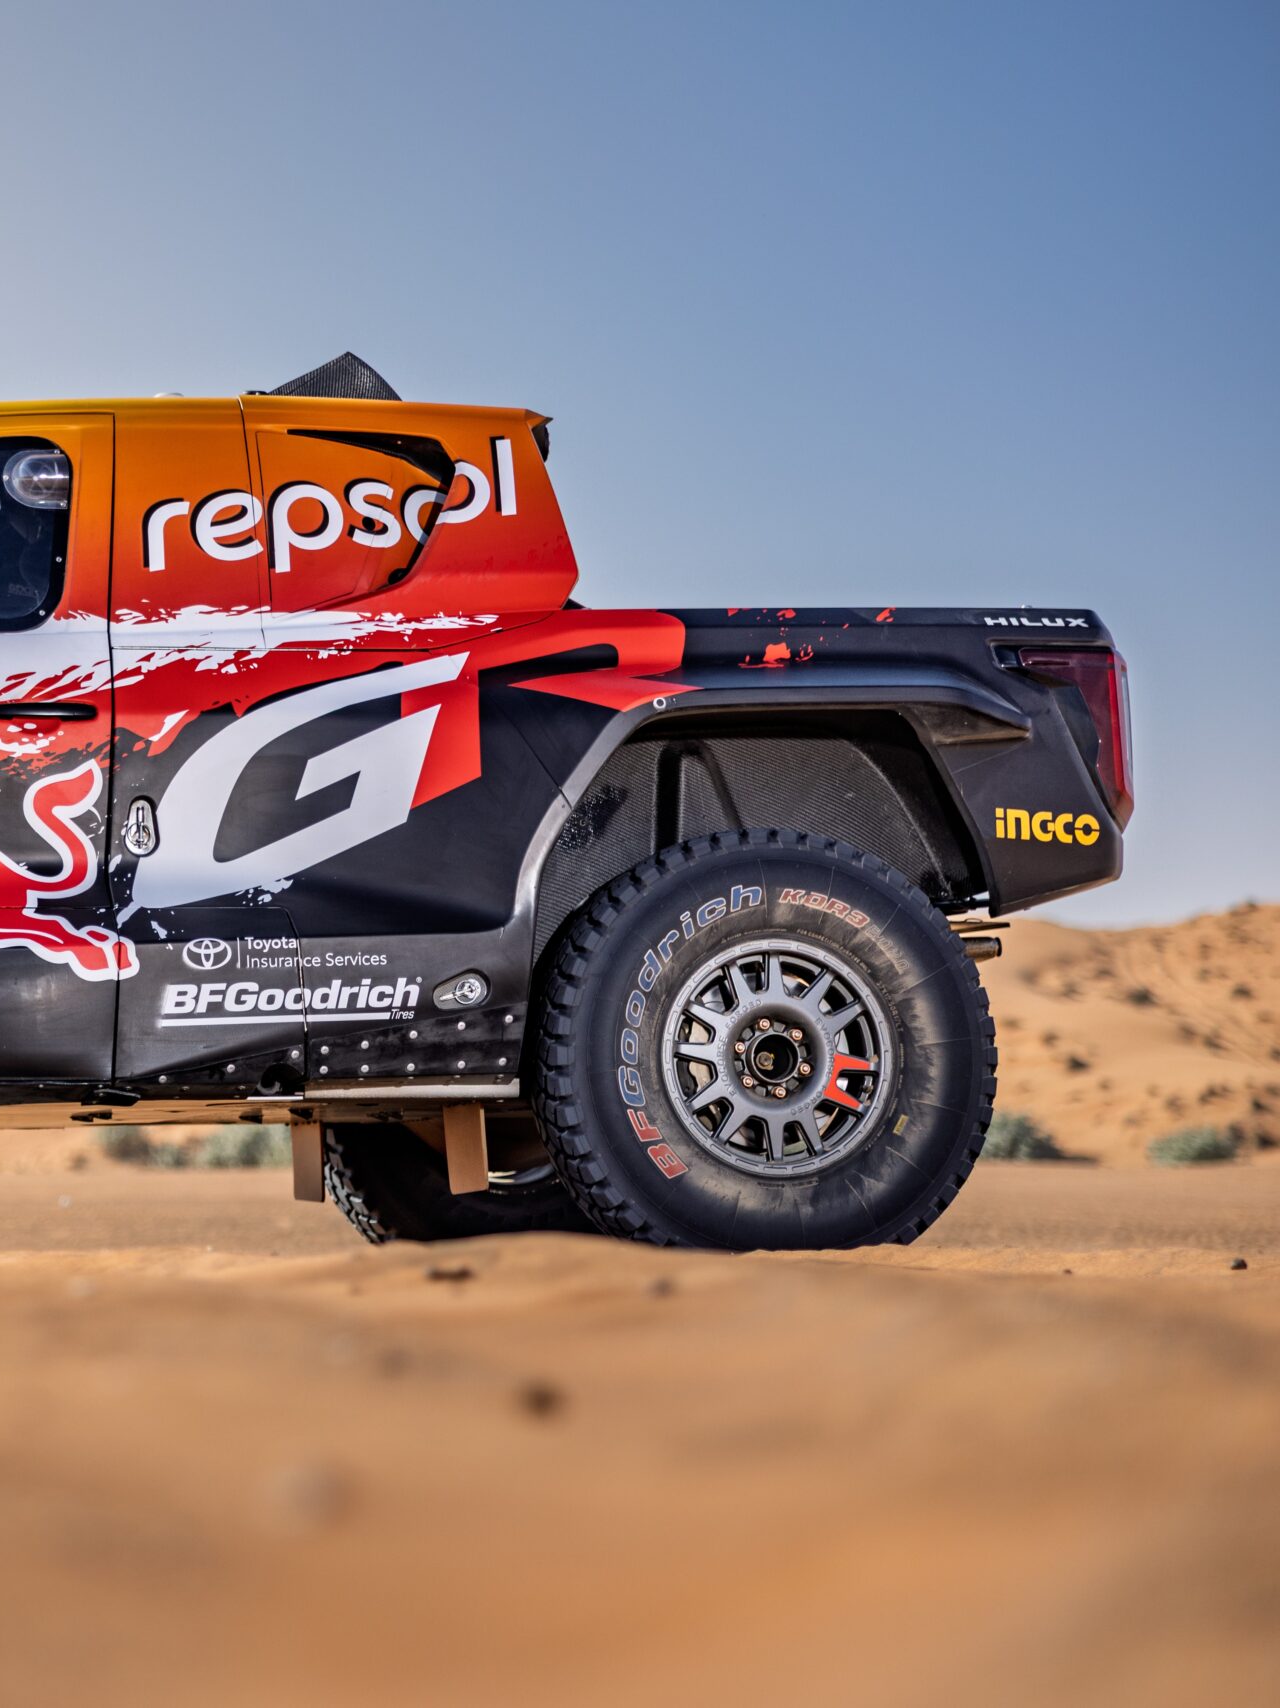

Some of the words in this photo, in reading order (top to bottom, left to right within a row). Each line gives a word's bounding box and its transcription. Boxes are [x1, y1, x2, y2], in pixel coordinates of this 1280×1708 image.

[143, 436, 517, 573] repsol
[984, 616, 1089, 628] HILUX
[778, 888, 870, 929] KDR3
[244, 936, 298, 952] Toyota
[246, 954, 321, 969] Insurance
[325, 952, 387, 967] Services
[161, 977, 422, 1015] BFGoodrich
[389, 1008, 415, 1020] Tires
[618, 884, 763, 1179] BFGoodrich
